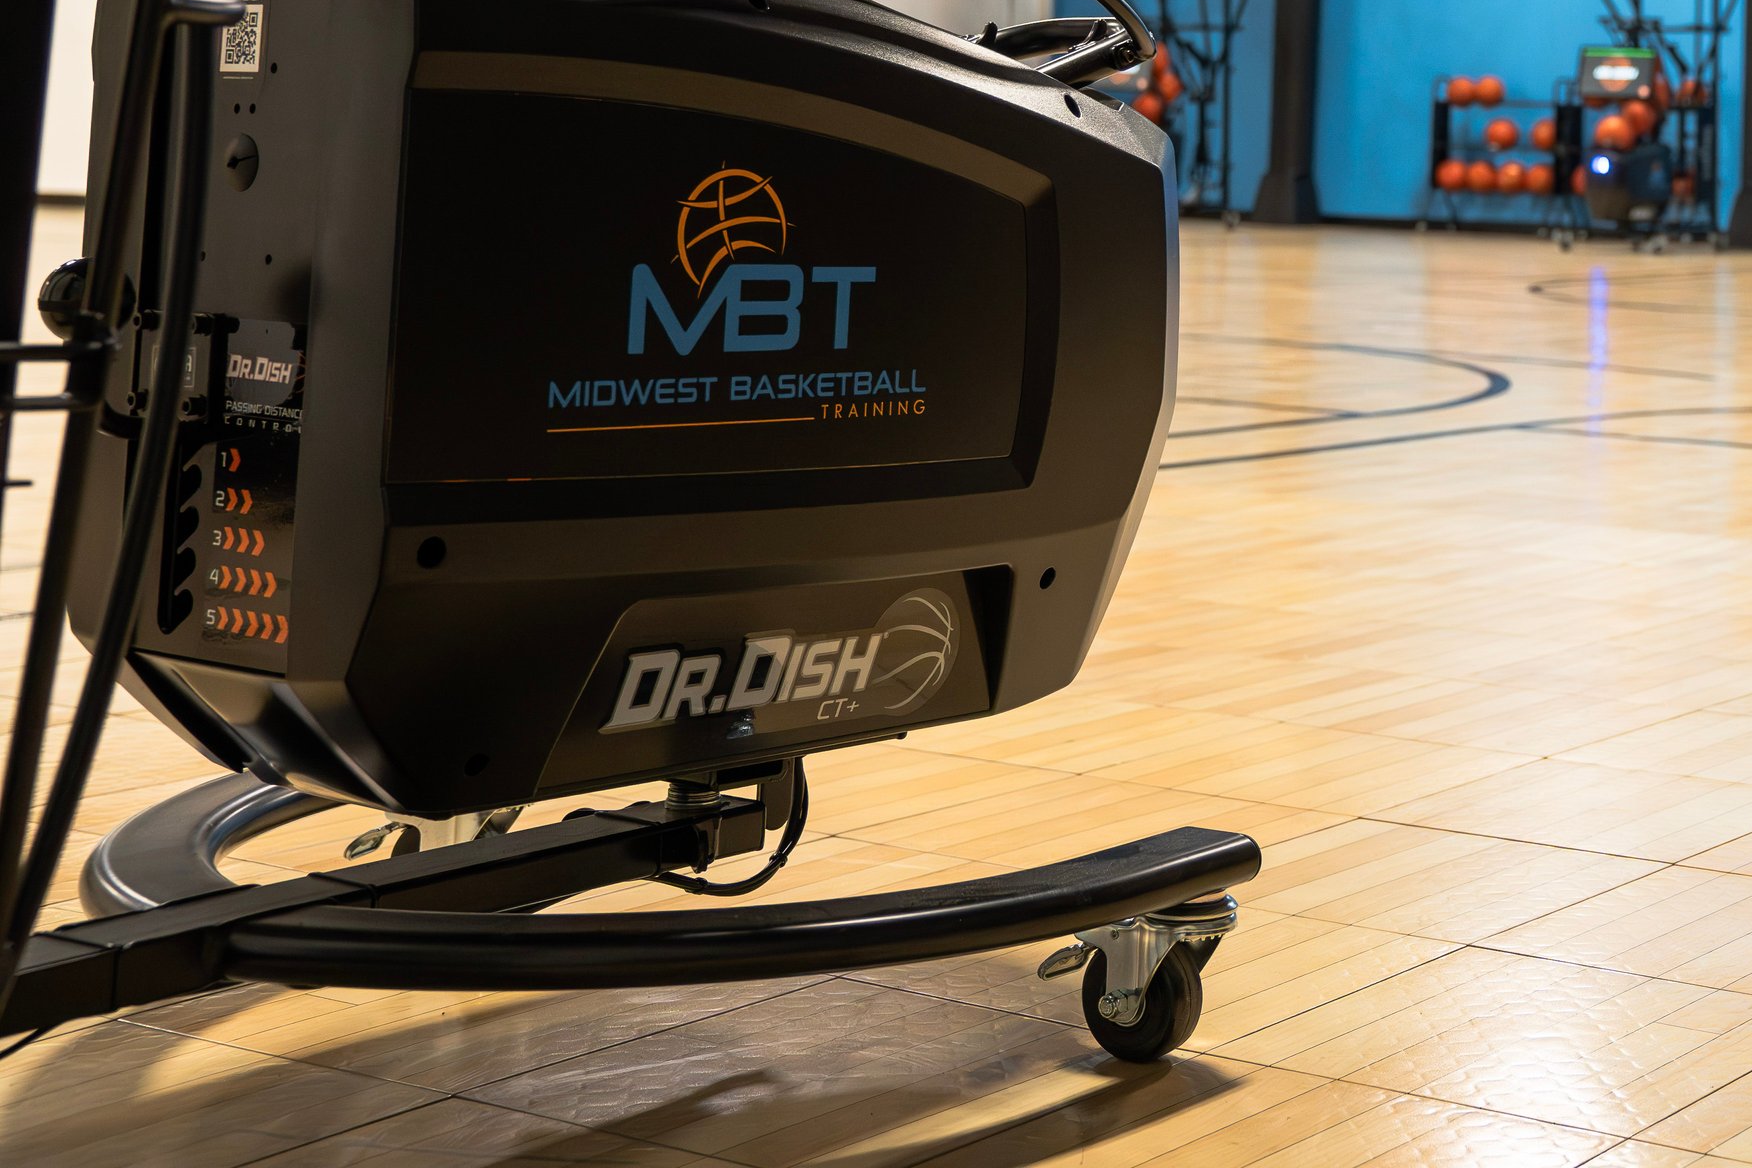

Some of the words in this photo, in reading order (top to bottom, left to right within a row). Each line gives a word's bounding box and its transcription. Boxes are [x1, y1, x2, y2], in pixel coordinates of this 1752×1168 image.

[627, 263, 876, 356] MBT
[547, 377, 718, 409] MIDWEST
[730, 368, 926, 402] BASKETBALL
[225, 400, 262, 415] PASSING
[821, 399, 926, 420] TRAINING
[220, 452, 227, 468] 1
[215, 490, 225, 507] 2
[212, 530, 222, 547] 3
[209, 568, 219, 585] 4
[206, 608, 216, 626] 5
[817, 697, 860, 721] CT+
